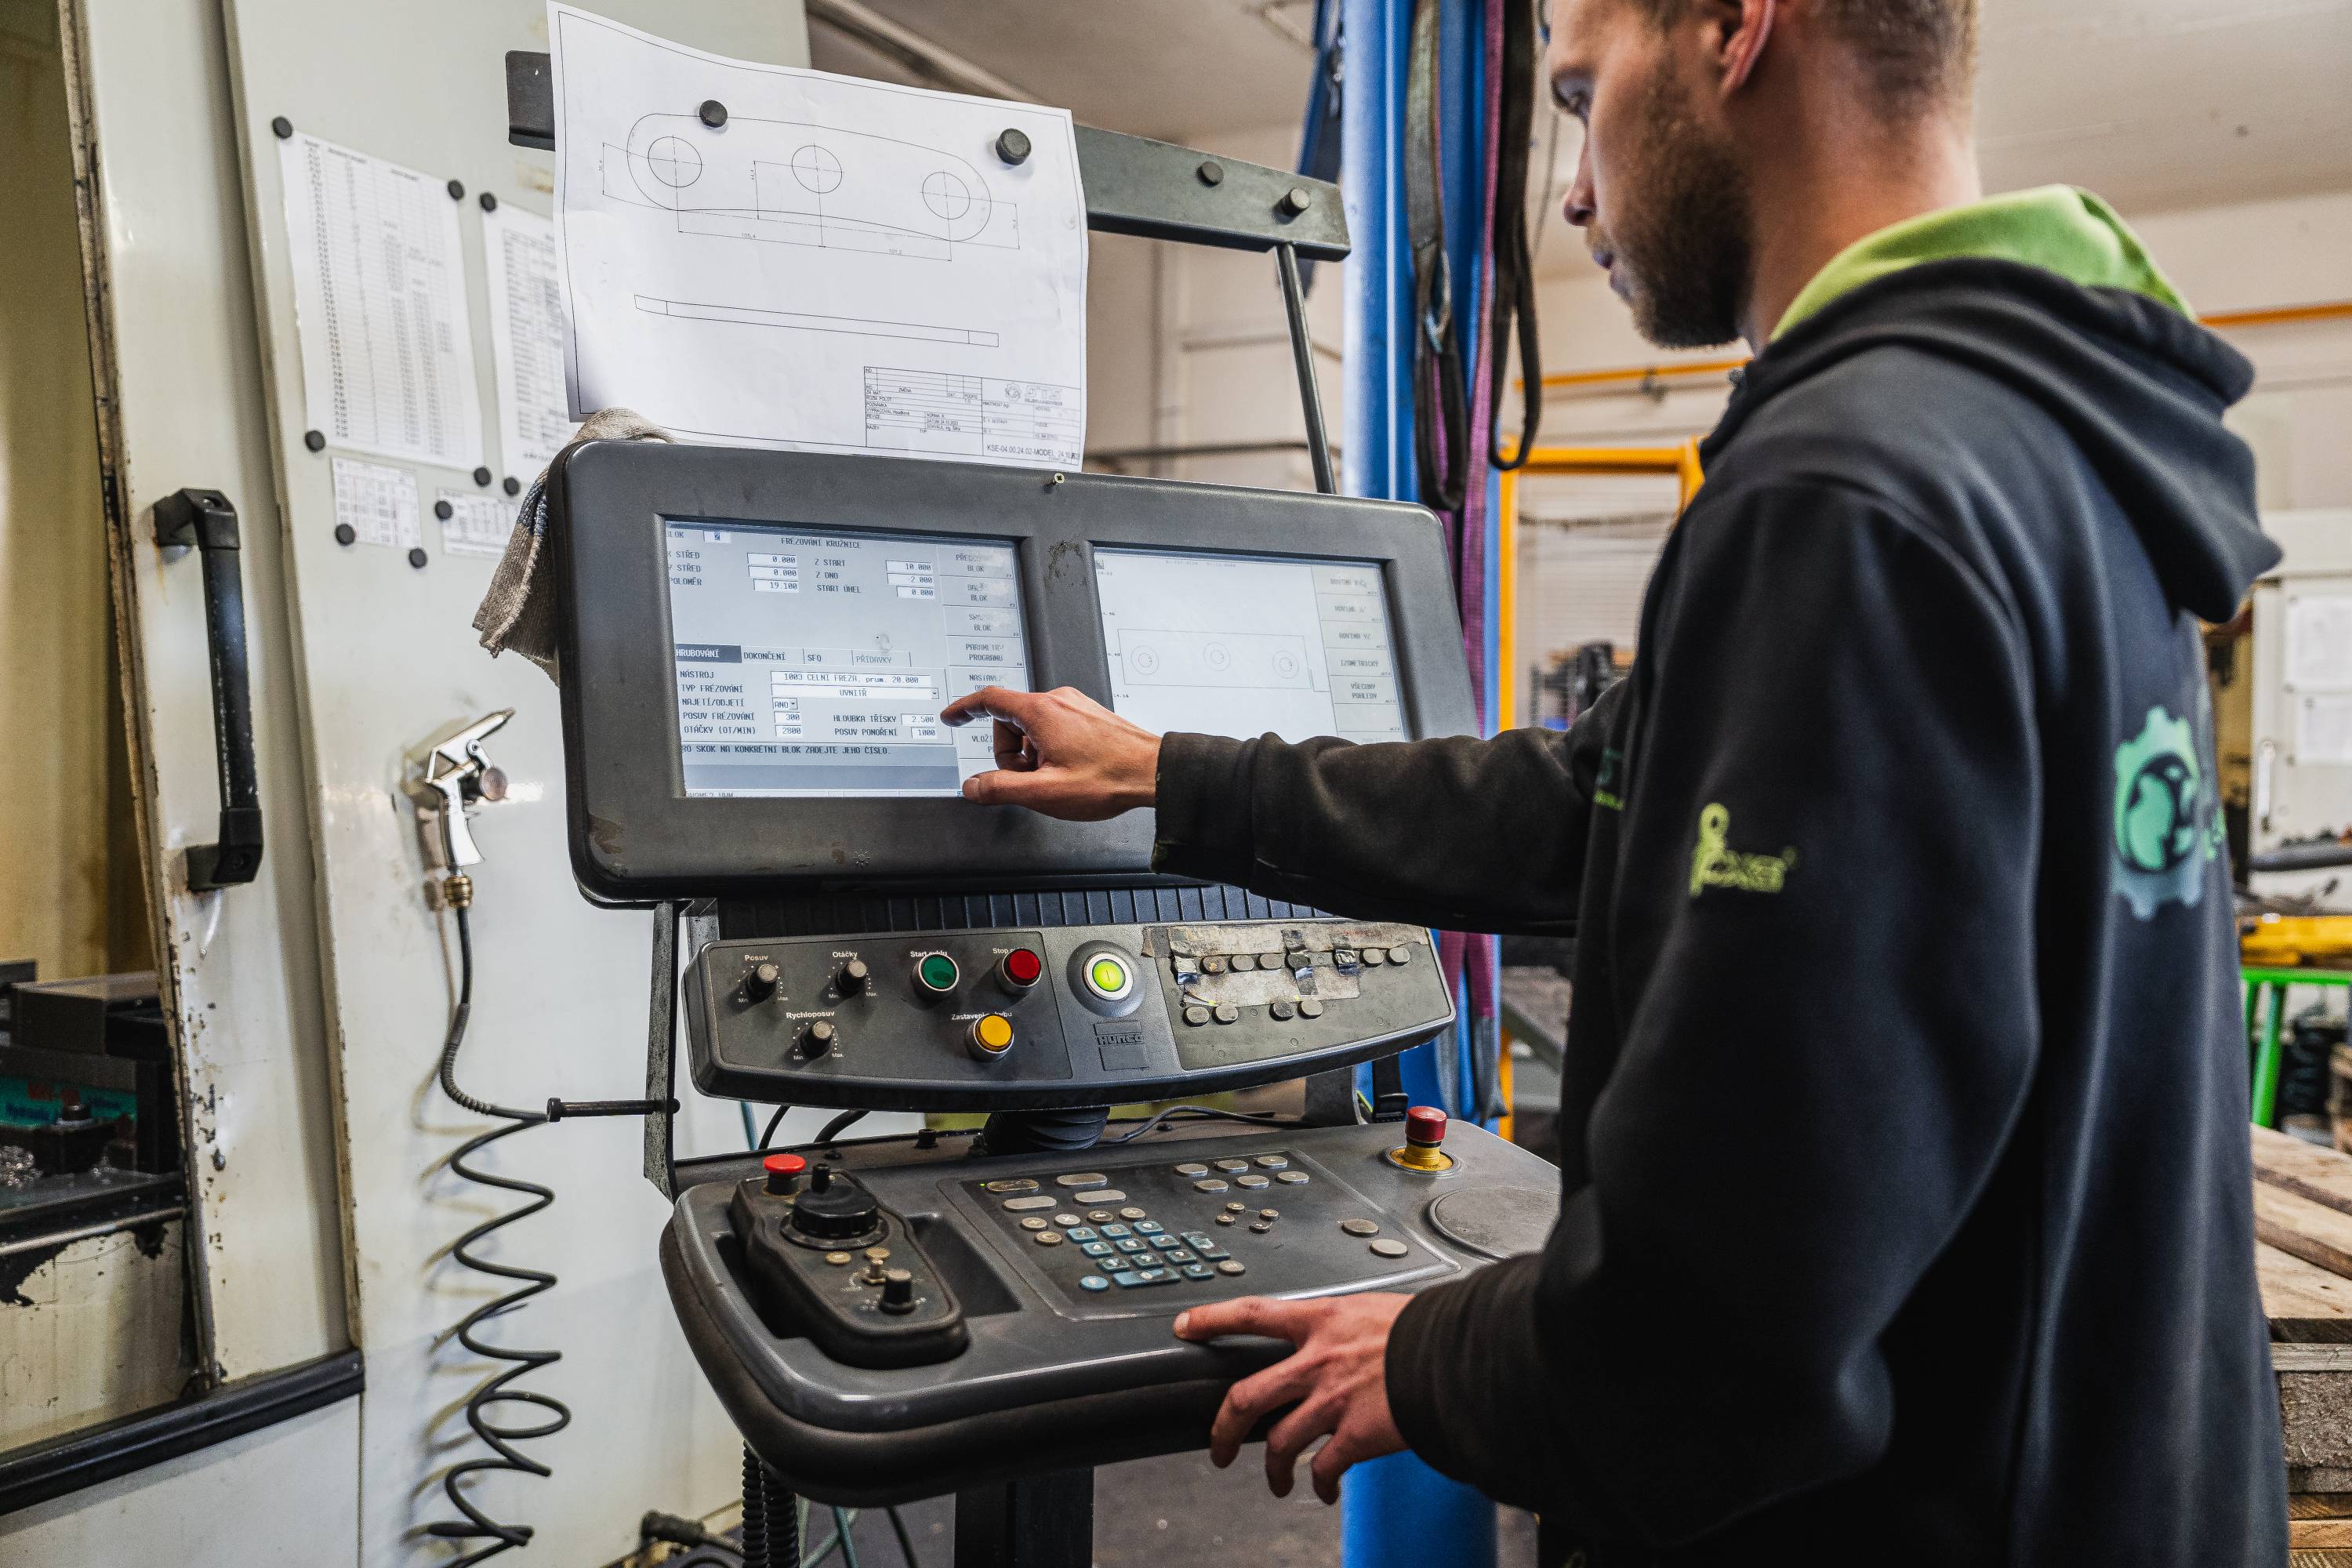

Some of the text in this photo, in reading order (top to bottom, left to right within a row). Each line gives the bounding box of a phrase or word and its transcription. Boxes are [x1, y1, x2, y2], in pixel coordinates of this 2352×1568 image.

[676, 550, 700, 559] STŘED
[677, 563, 702, 572] STŘED
[906, 562, 931, 572] 10.000
[816, 584, 840, 593] START
[675, 648, 720, 658] HRUBOVÁNÍ
[744, 651, 786, 661] DOKONČENÍ
[680, 670, 714, 679] NÁSTROJ
[682, 698, 744, 706] NAJETÍ/ODJETÍ
[870, 713, 897, 723] TŘÍSKY
[684, 724, 713, 734] OTÁČKY
[862, 728, 898, 736] PONOŘENÍ
[842, 746, 861, 754] JEHO
[832, 950, 858, 960] Otáčky
[786, 1011, 835, 1020] Rychloposuv
[1098, 1034, 1143, 1045] HURCO
